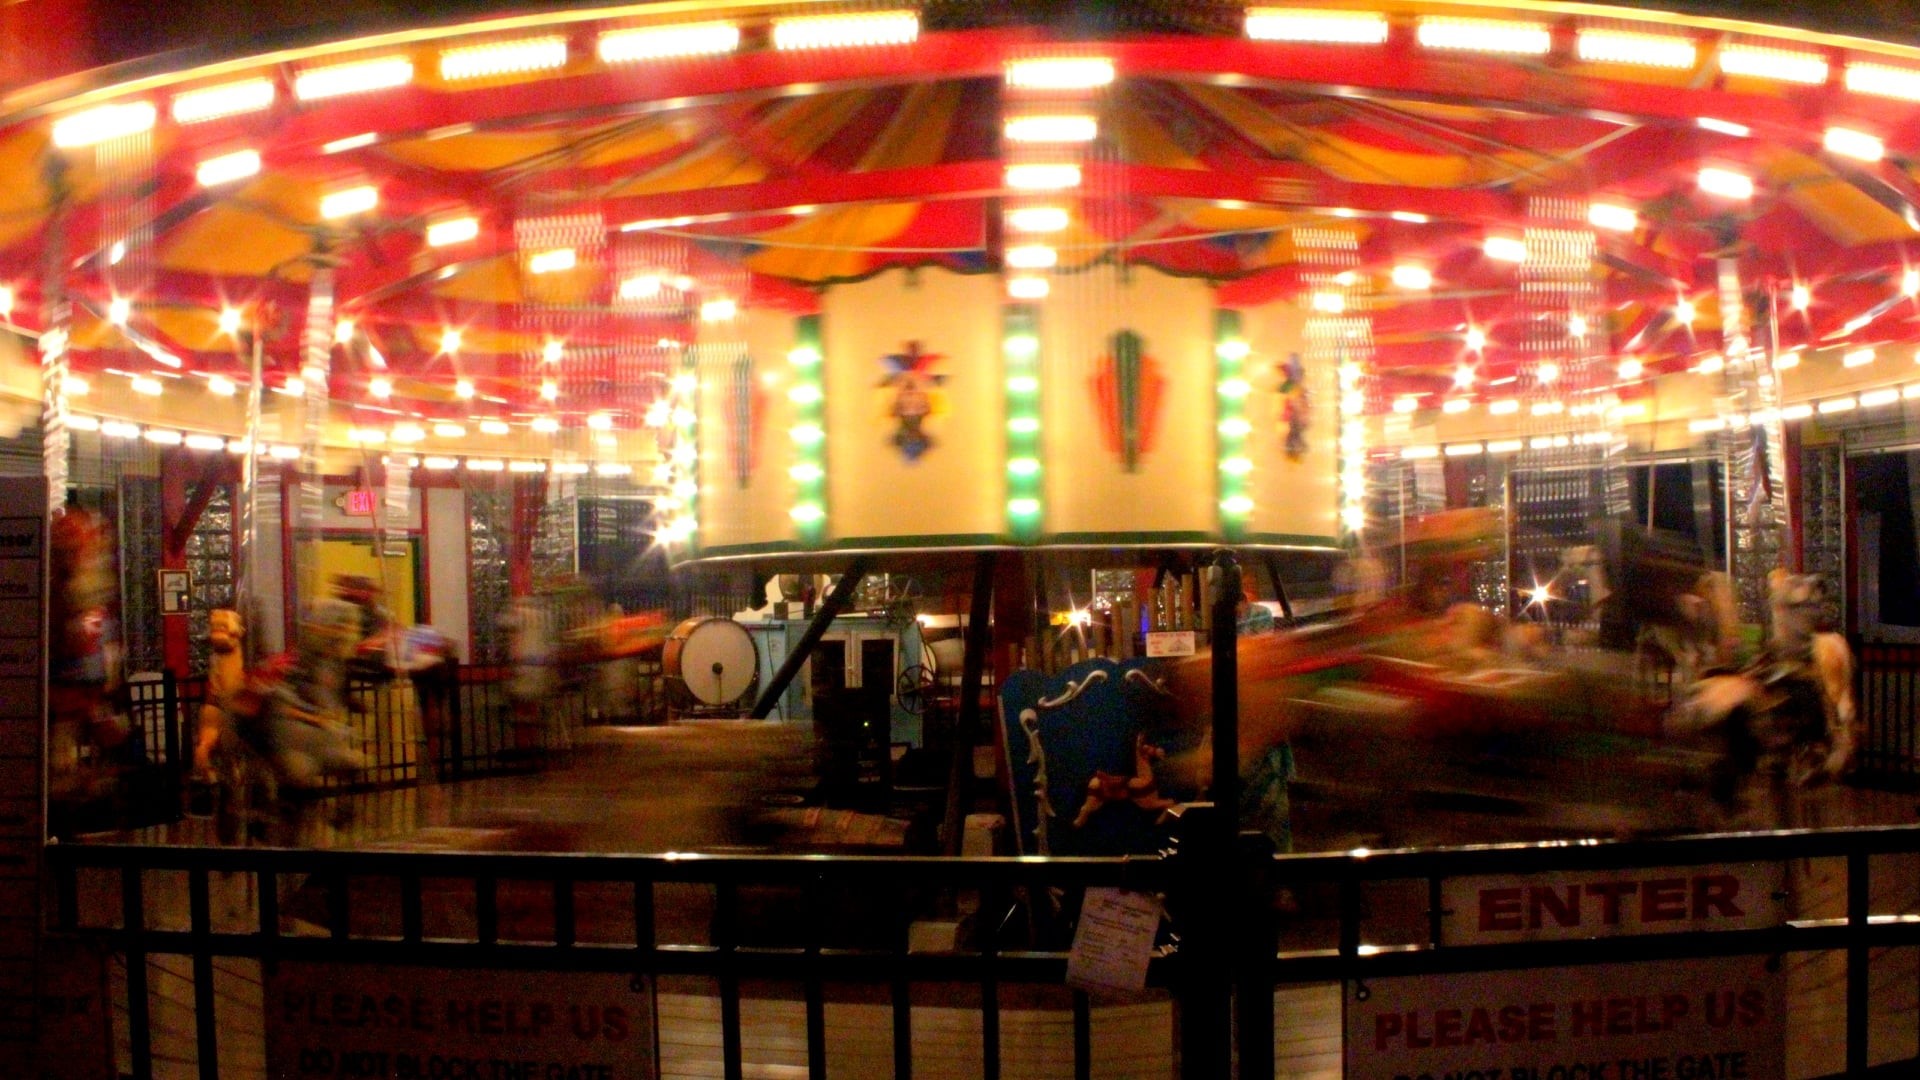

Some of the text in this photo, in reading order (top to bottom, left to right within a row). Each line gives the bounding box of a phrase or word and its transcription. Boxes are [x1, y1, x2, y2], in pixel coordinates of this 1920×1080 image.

[1479, 874, 1745, 931] ENTER
[283, 989, 628, 1041] PLEASE HELP US
[1375, 989, 1767, 1050] PLEASE HELP US
[301, 1049, 613, 1080] DO NOT BLOCK THE GATE
[1619, 1056, 1669, 1080] THE
[1676, 1052, 1749, 1080] GATE
